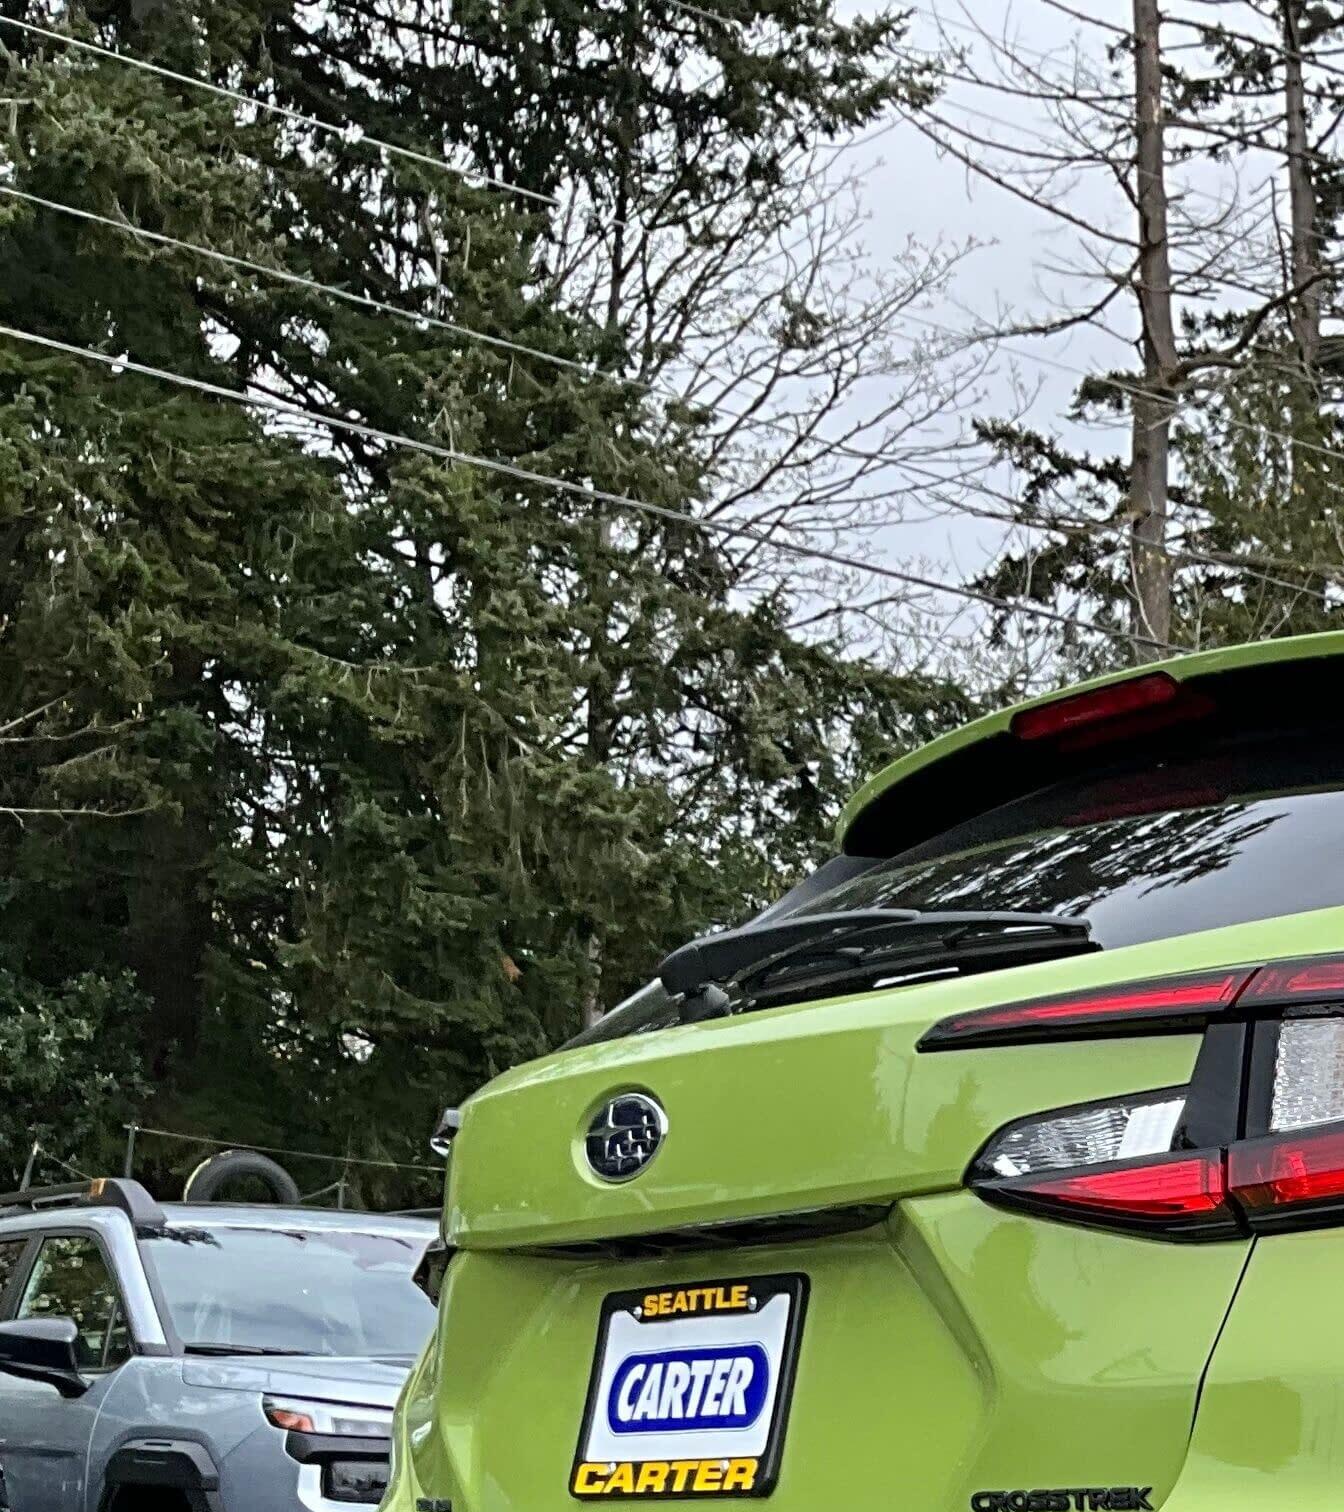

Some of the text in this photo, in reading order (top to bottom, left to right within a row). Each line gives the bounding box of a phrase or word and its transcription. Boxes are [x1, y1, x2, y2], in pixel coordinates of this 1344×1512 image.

[643, 1285, 748, 1317] SEATTLE
[617, 1357, 754, 1422] CARTER
[573, 1458, 758, 1494] CARTER
